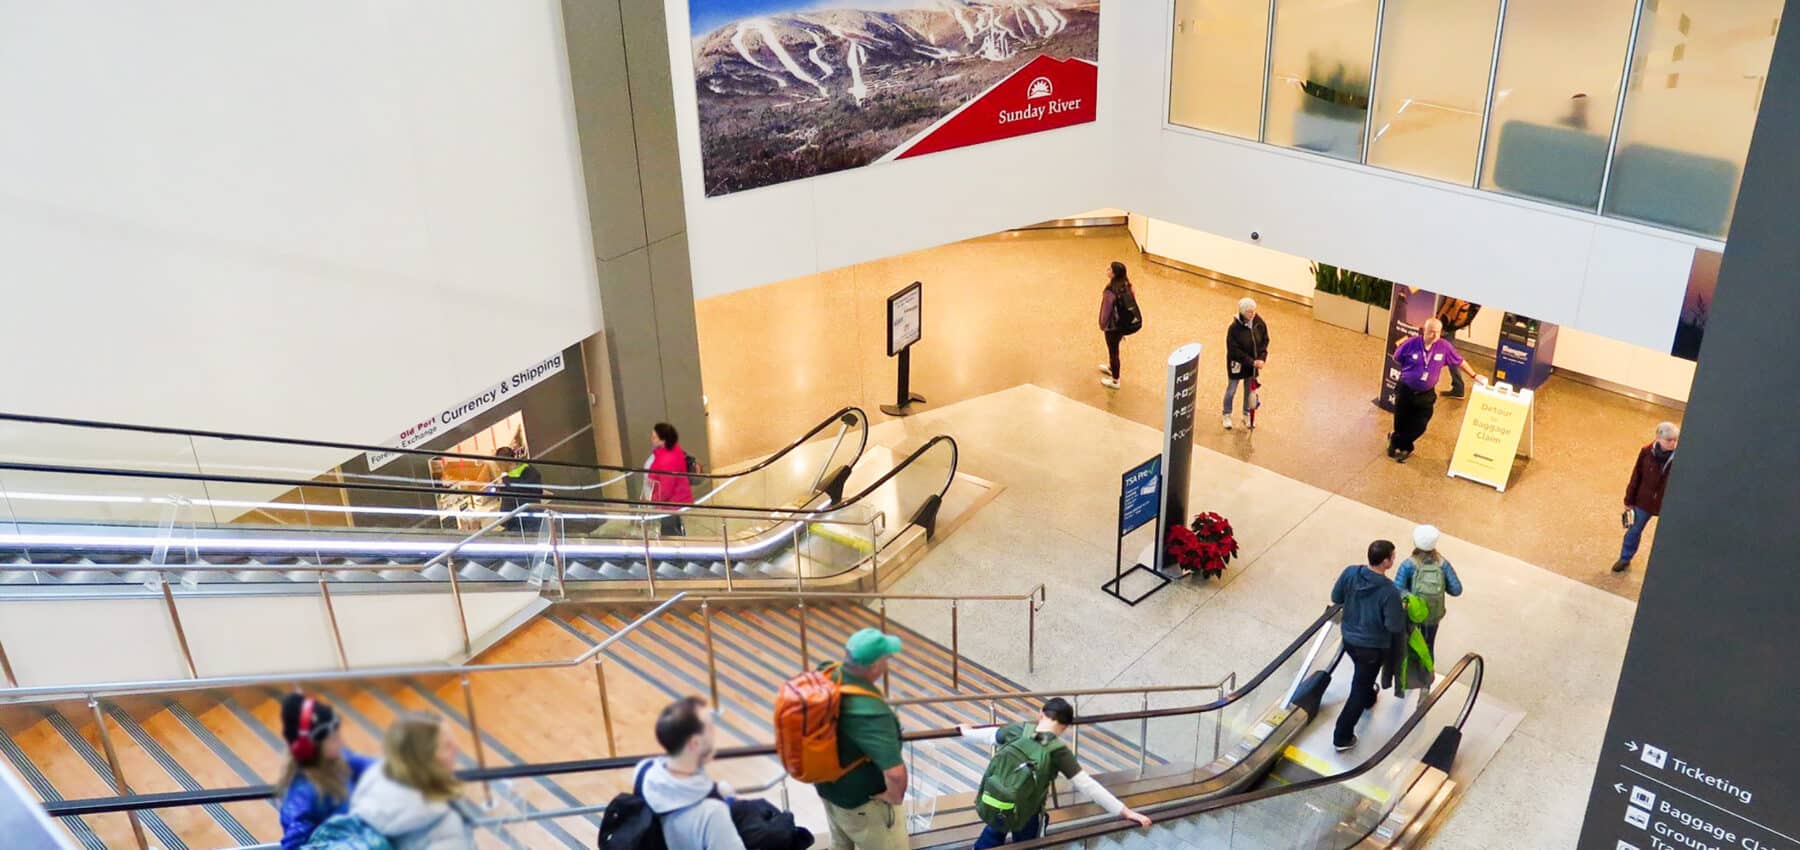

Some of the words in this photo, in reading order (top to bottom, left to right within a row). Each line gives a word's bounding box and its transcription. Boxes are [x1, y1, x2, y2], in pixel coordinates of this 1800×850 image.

[998, 104, 1045, 124] Sunday
[1048, 98, 1082, 114] River
[441, 389, 497, 425] Currency
[500, 381, 509, 393] &
[511, 355, 561, 388] Shipping
[1481, 403, 1512, 416] Detour
[400, 427, 415, 439] Old
[417, 417, 436, 430] Port
[401, 427, 438, 448] Exchange
[1473, 418, 1511, 435] Baggage
[1476, 431, 1500, 444] Claim
[1672, 757, 1753, 804] Ticketing
[1660, 800, 1736, 843] Baggage
[1654, 821, 1720, 850] Groun
